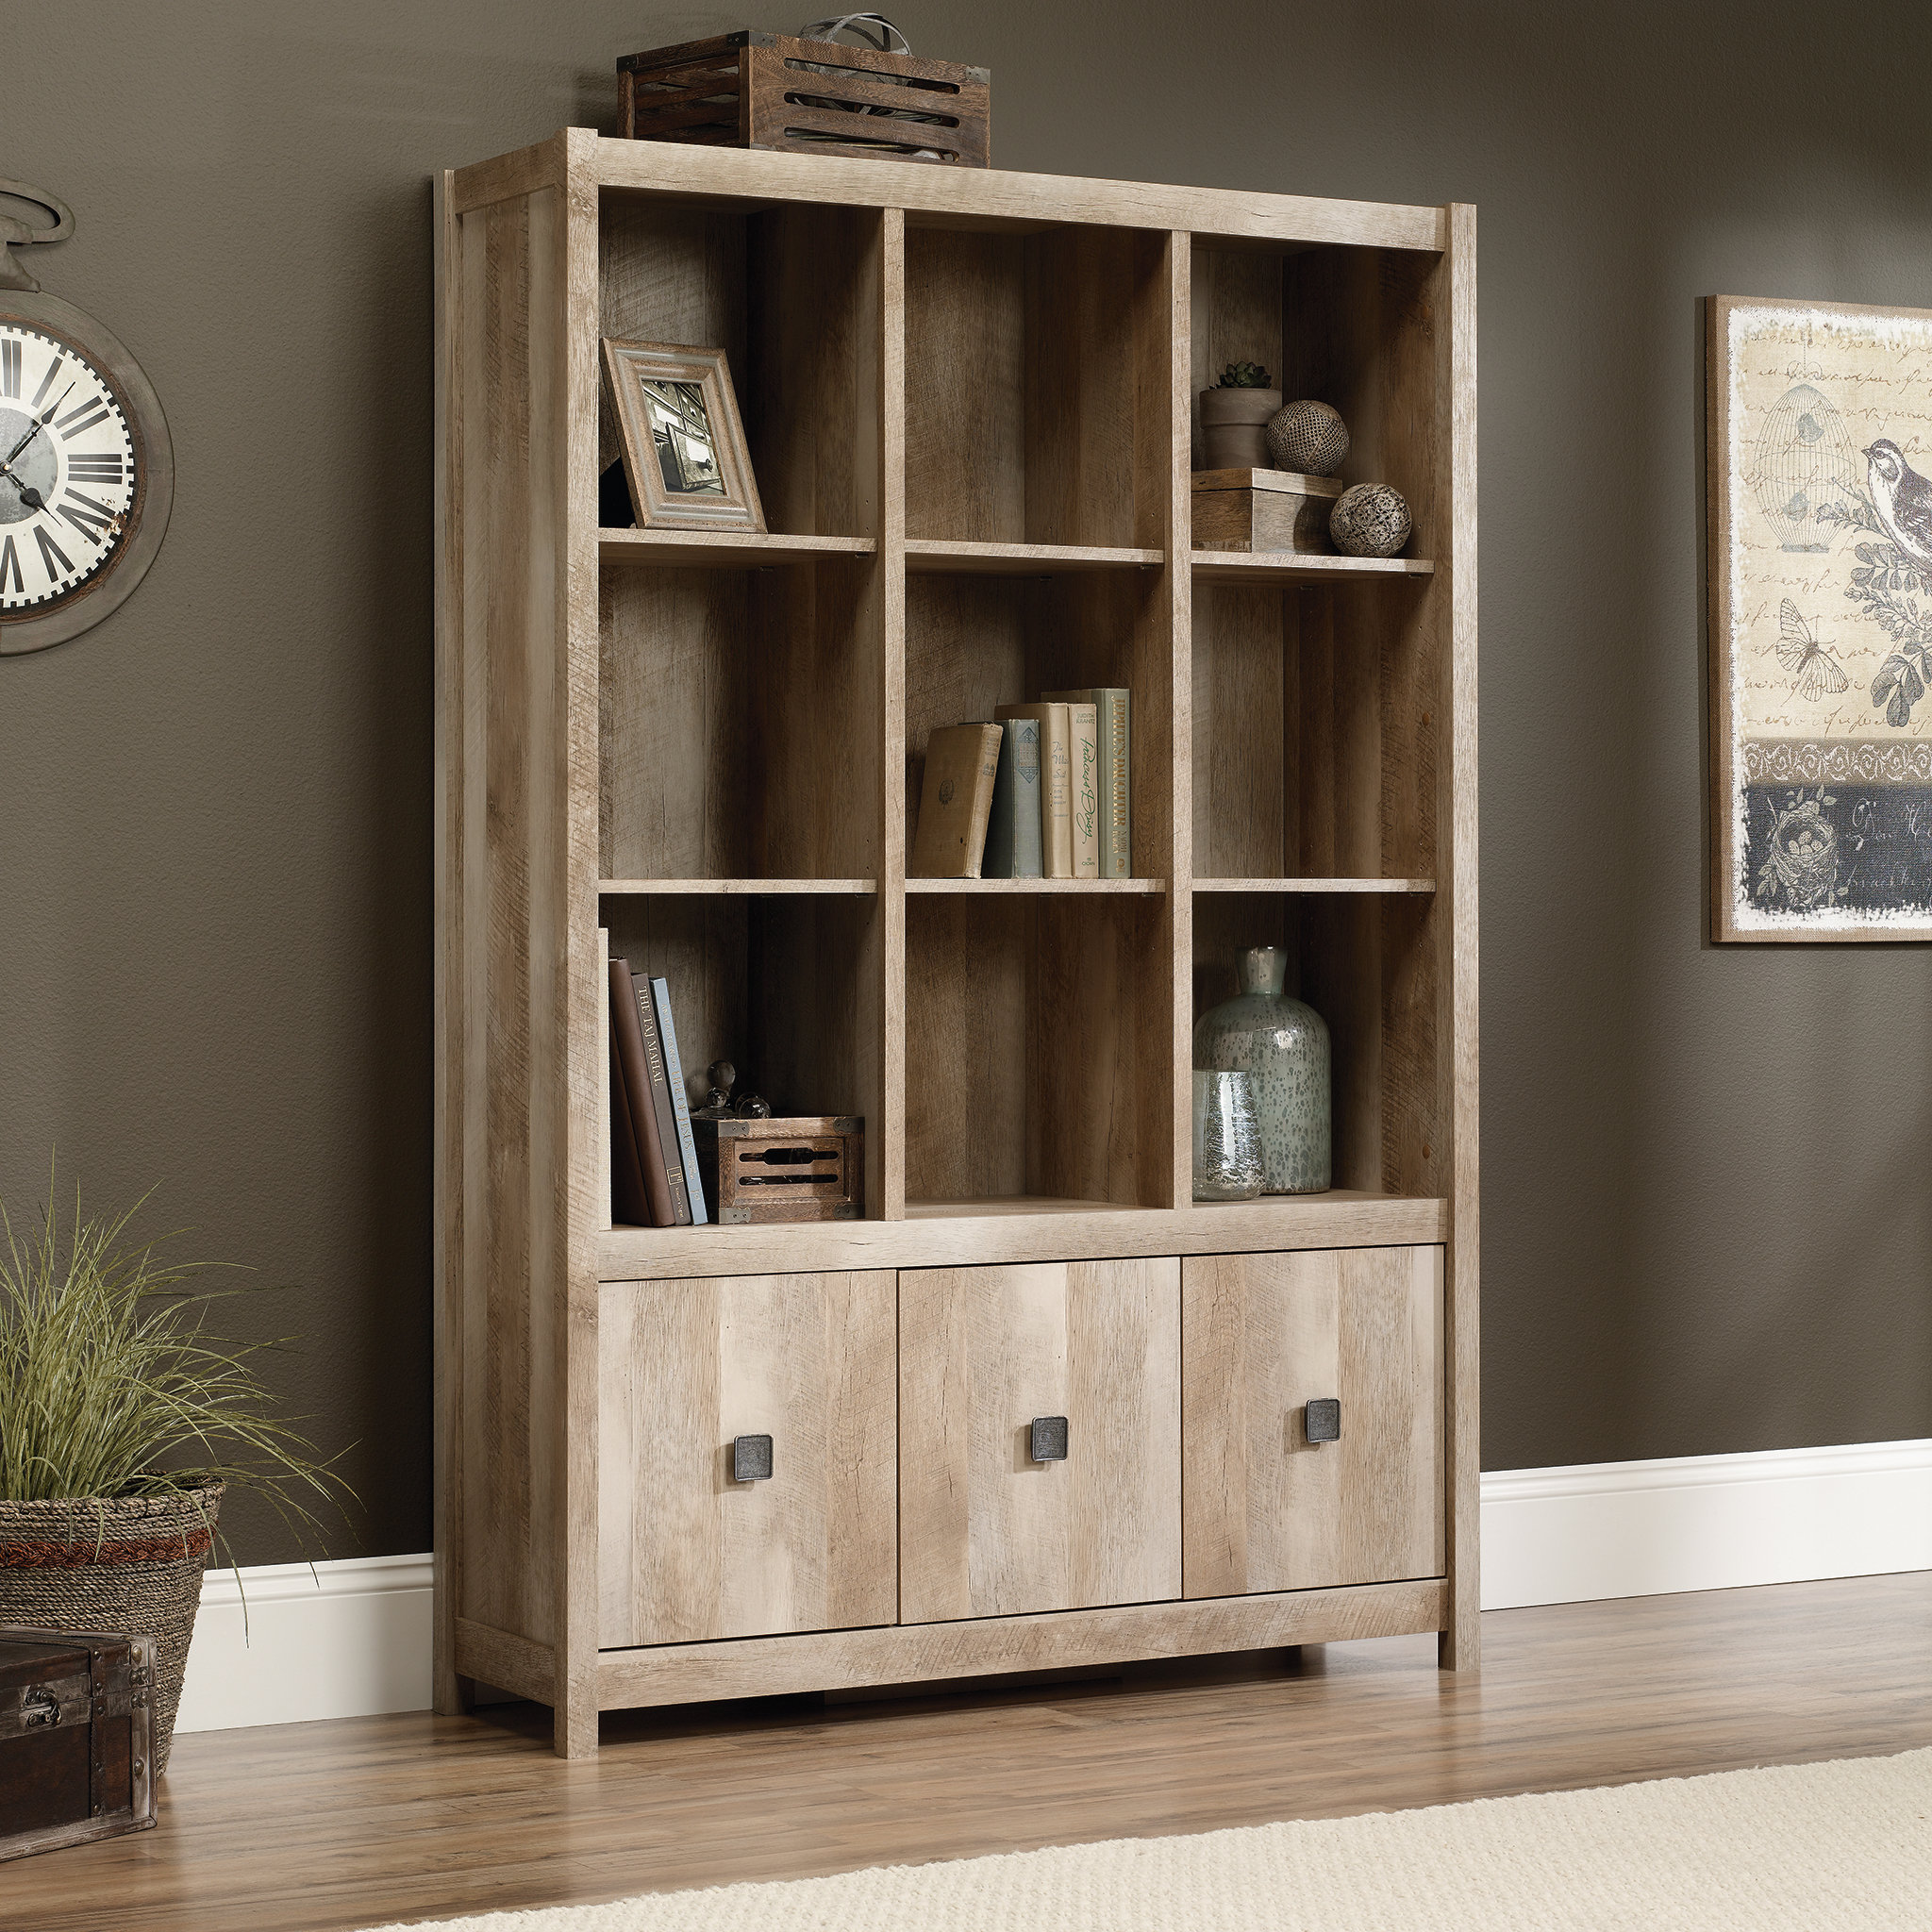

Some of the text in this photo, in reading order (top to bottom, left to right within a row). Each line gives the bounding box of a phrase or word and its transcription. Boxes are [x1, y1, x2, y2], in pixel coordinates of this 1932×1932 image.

[0, 339, 22, 400] II
[54, 395, 110, 442] II
[67, 453, 123, 484] III
[32, 525, 76, 584] V
[1075, 737, 1096, 844] Princess Daisy
[1112, 758, 1125, 826] DAUGHTER
[638, 985, 664, 1087] THE TAJ MAHAL
[672, 1070, 685, 1096] LIFE
[676, 1097, 688, 1113] OF
[675, 1117, 693, 1150] JESUS
